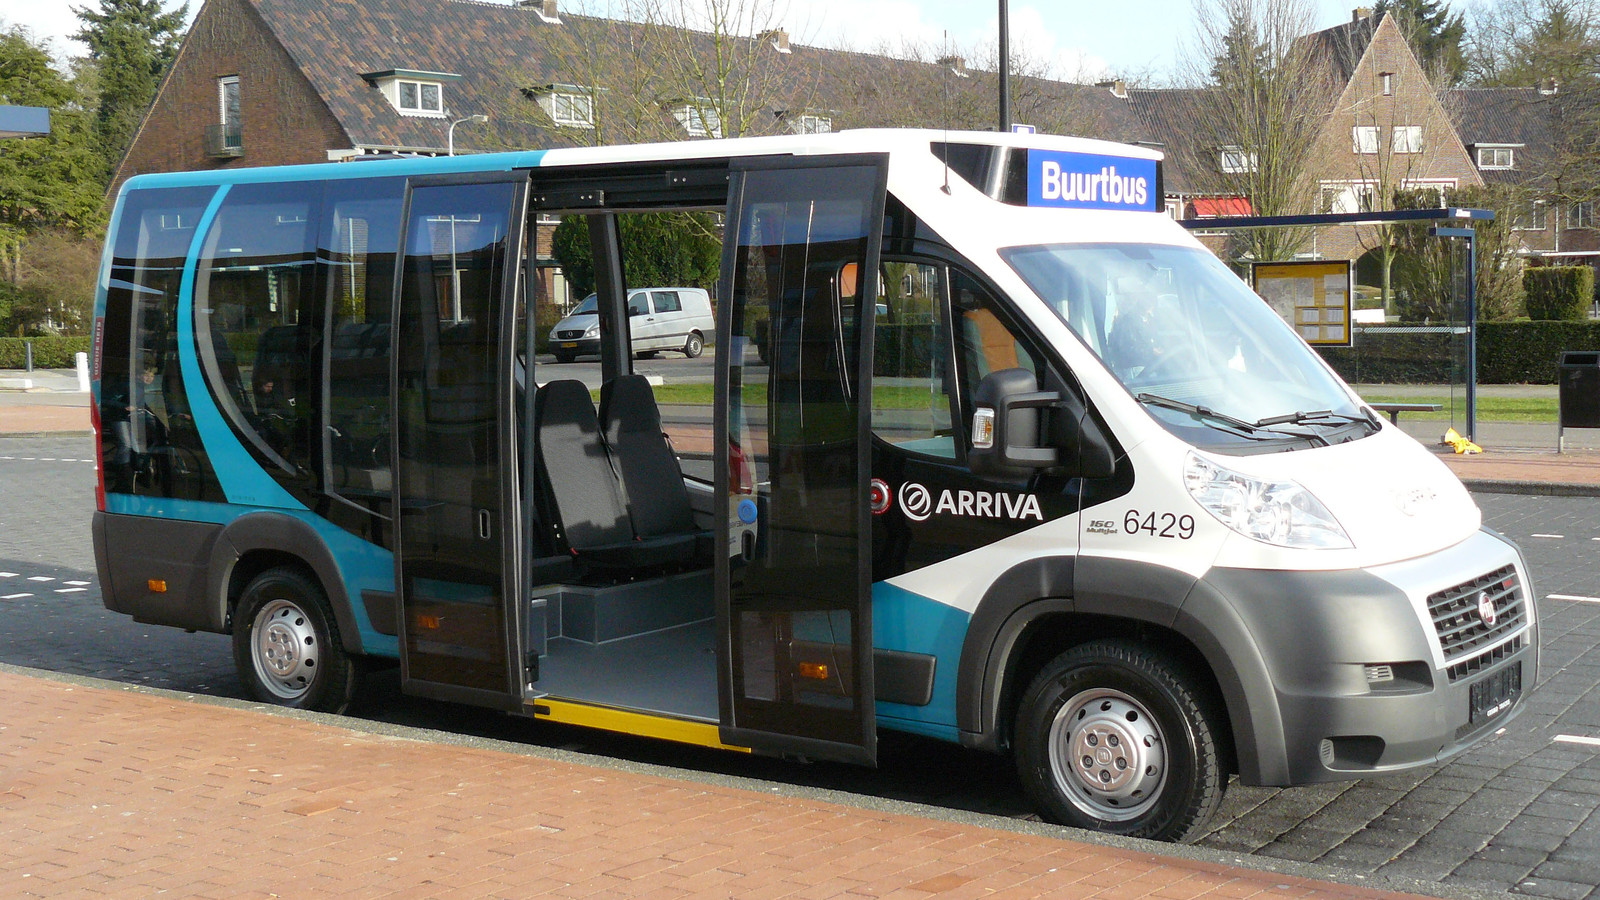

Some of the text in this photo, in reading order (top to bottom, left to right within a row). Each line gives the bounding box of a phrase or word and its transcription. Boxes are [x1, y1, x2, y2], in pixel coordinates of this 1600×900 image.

[1042, 160, 1147, 205] Buurtbus
[935, 489, 1044, 521] ARRIVA
[1089, 520, 1115, 528] 160
[1123, 509, 1195, 540] 6429
